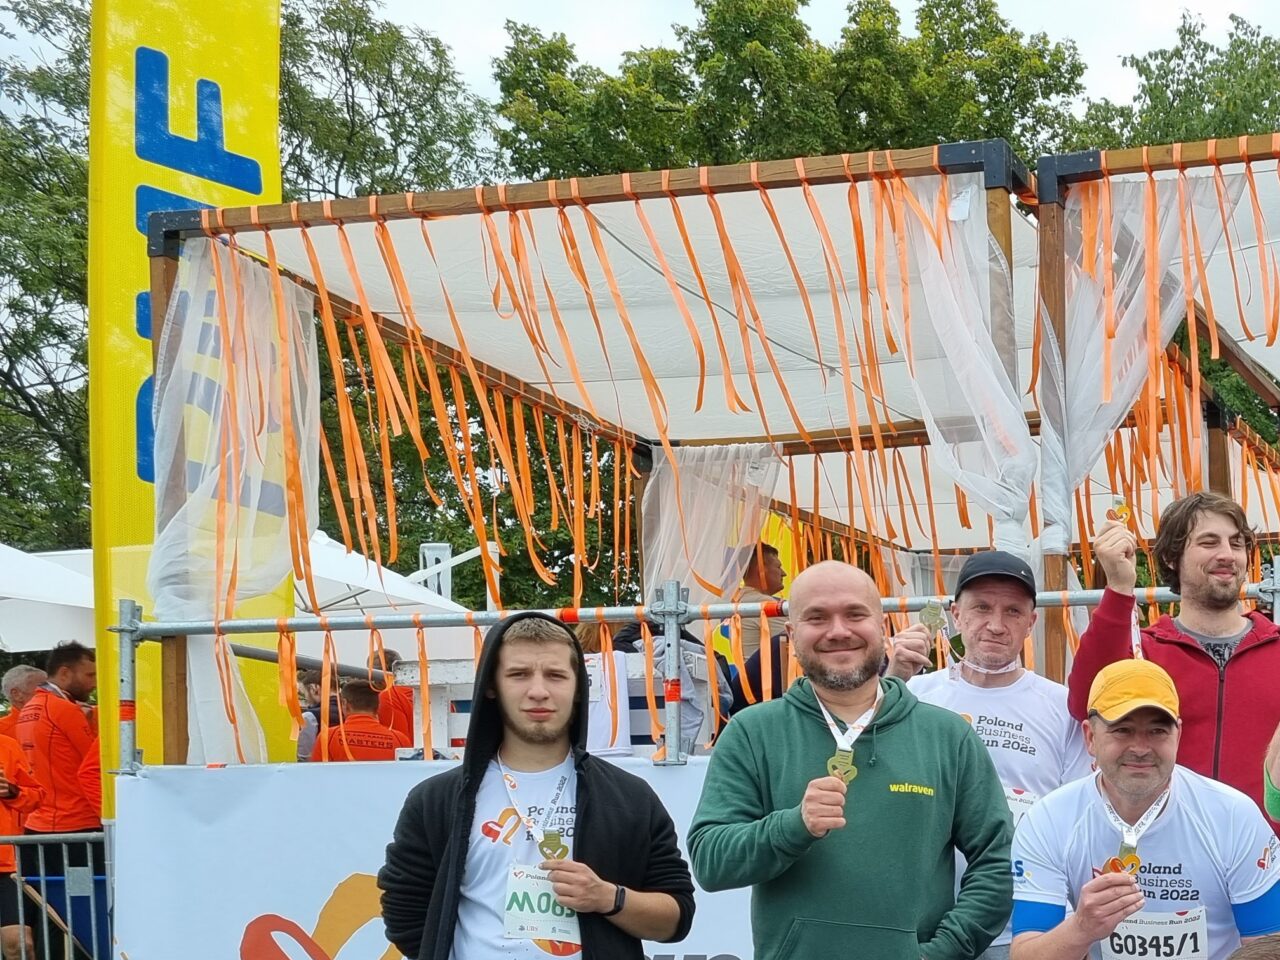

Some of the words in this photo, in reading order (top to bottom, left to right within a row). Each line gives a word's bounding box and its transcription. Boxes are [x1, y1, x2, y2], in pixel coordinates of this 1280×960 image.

[977, 715, 1023, 732] Poland
[976, 725, 1031, 745] Business
[982, 739, 999, 748] un
[1002, 739, 1036, 756] 2022
[556, 775, 568, 793] 2022
[889, 782, 934, 797] walraven
[527, 805, 577, 817] Pond
[1131, 862, 1182, 875] oland
[525, 873, 550, 882] Polan
[1140, 889, 1157, 900] un
[1159, 888, 1200, 901] 2022
[1138, 918, 1169, 926] Business
[1184, 915, 1201, 924] 2022
[1109, 931, 1200, 957] G0345/1
